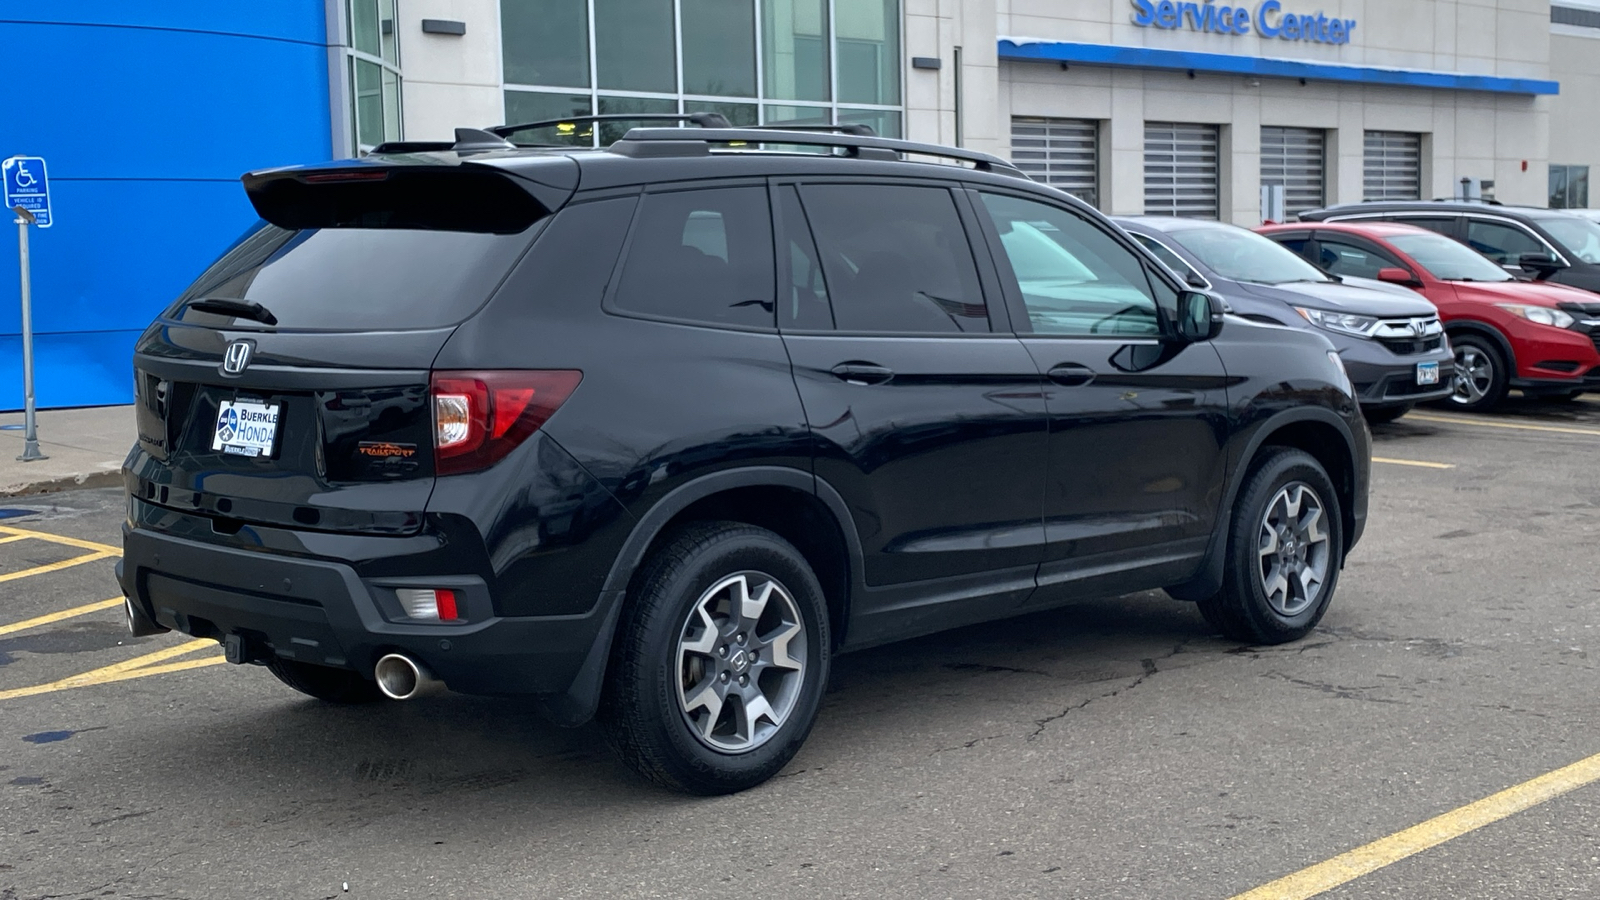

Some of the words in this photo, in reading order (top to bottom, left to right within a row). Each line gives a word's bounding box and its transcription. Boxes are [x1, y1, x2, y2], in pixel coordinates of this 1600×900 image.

[1133, 0, 1250, 35] Service
[1254, 0, 1357, 44] Center
[241, 409, 278, 423] BUERKLE
[237, 422, 274, 443] HONDA
[360, 446, 415, 457] TRAILSPORT
